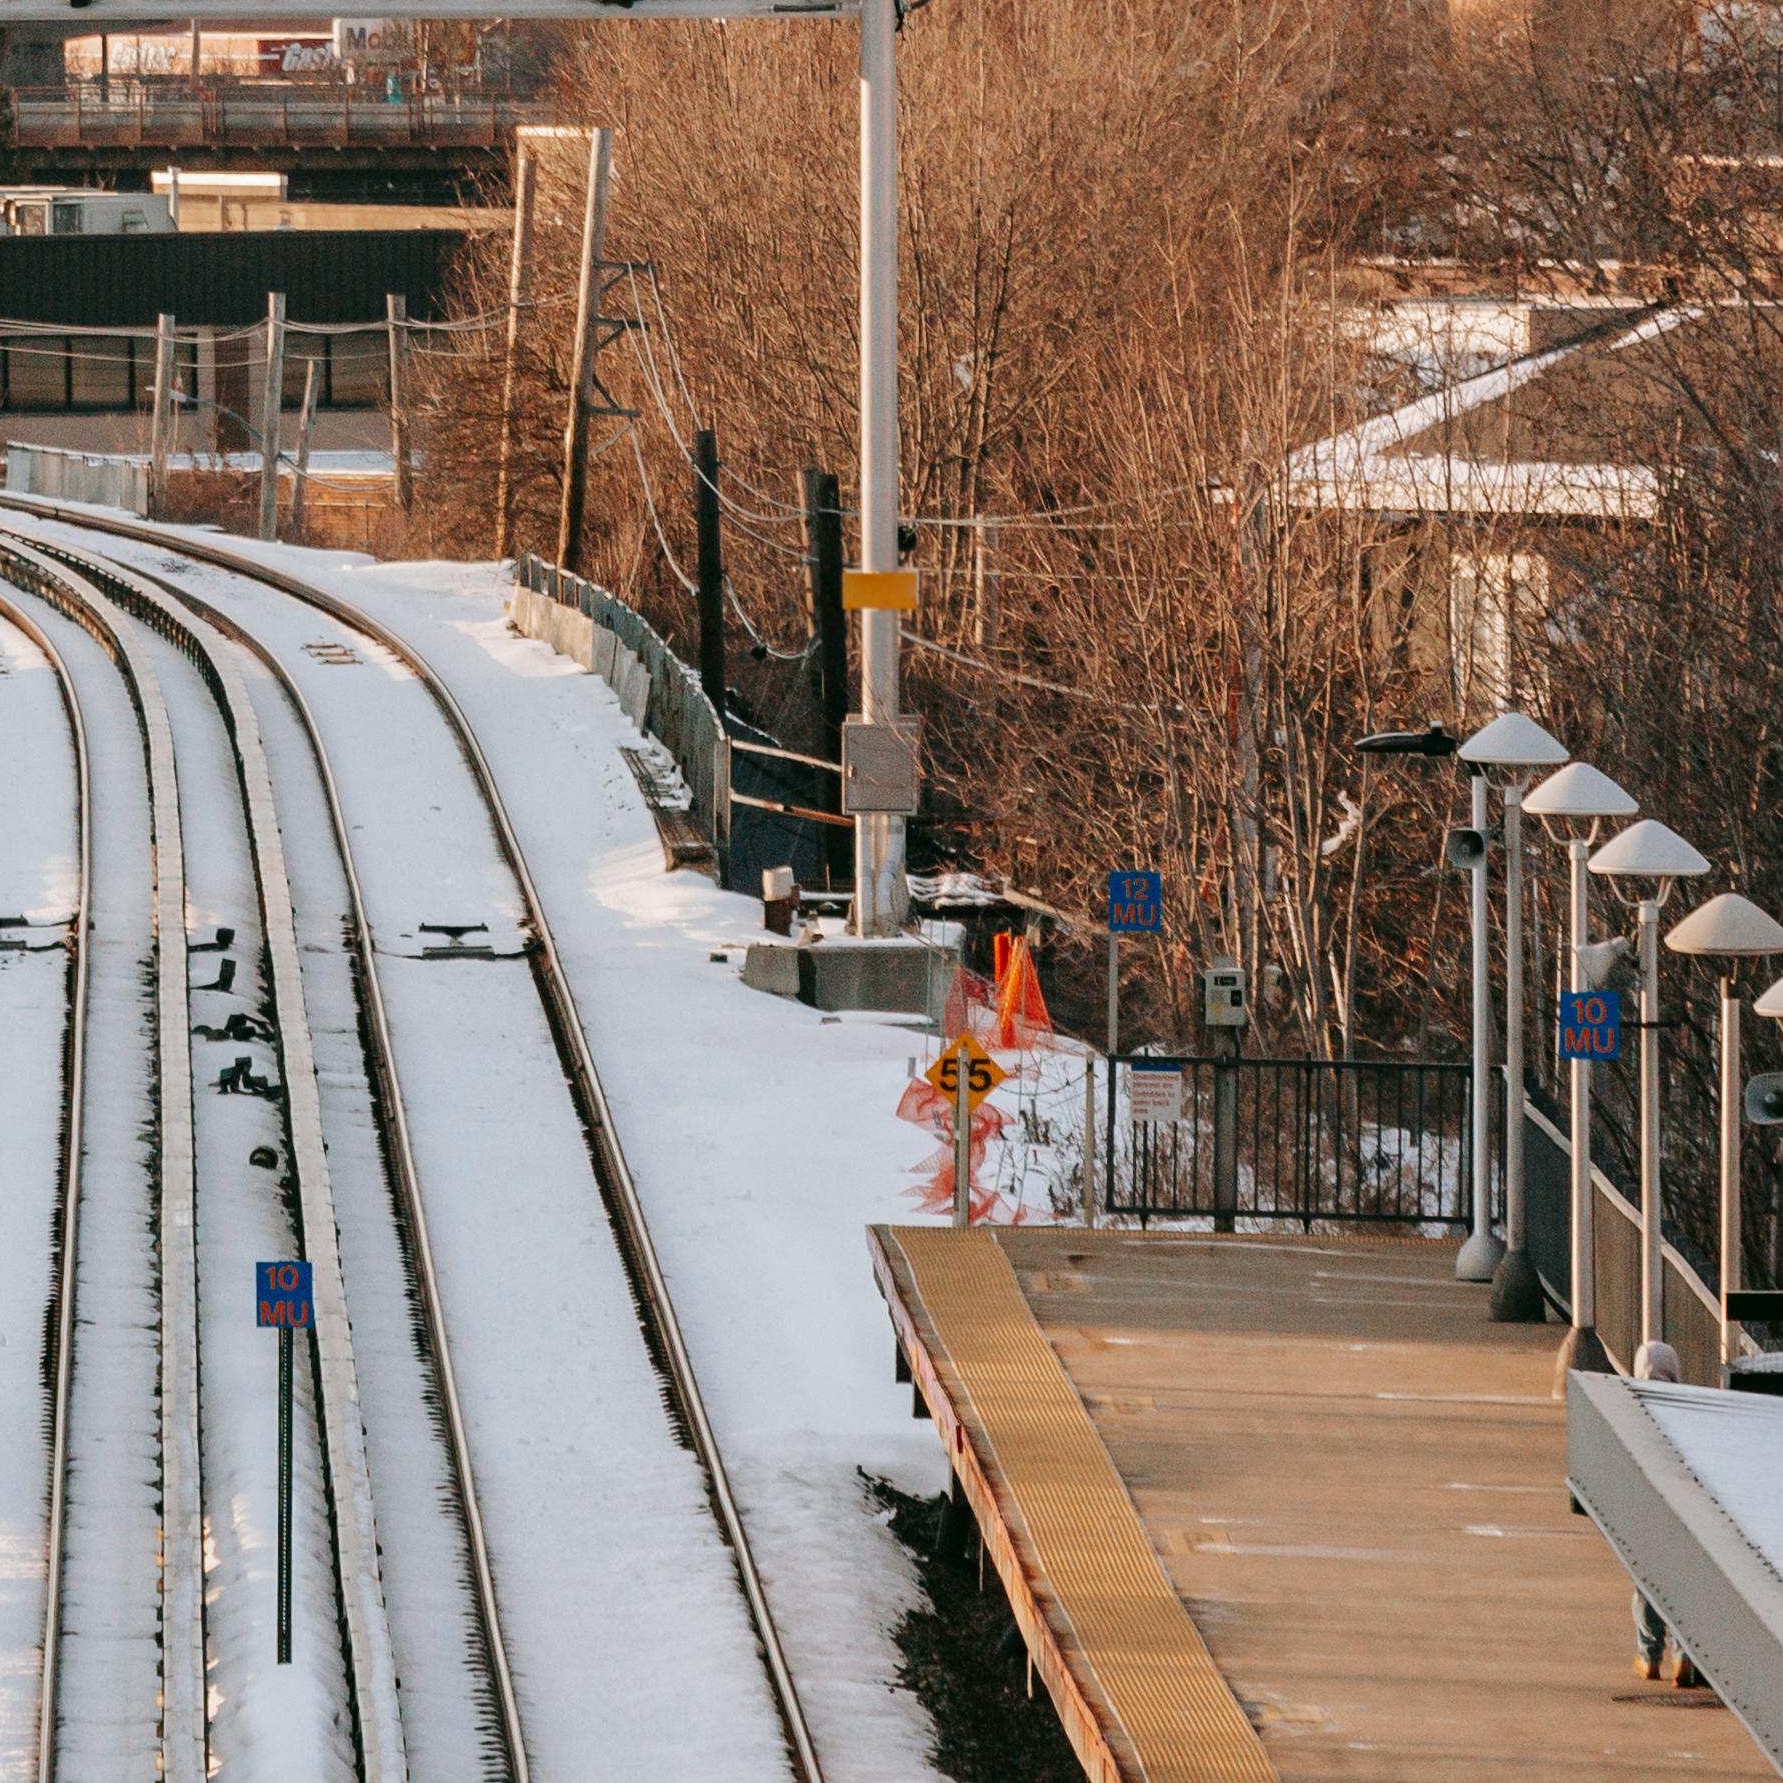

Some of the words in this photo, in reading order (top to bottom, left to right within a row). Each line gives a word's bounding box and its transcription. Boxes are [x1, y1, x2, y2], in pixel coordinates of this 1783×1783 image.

[1122, 878, 1149, 900] 12
[1114, 903, 1156, 926] MU
[1571, 998, 1607, 1024] 10
[1565, 1027, 1614, 1053] MU
[939, 1058, 993, 1092] 55
[264, 1264, 299, 1291] 10
[260, 1300, 309, 1327] MU
